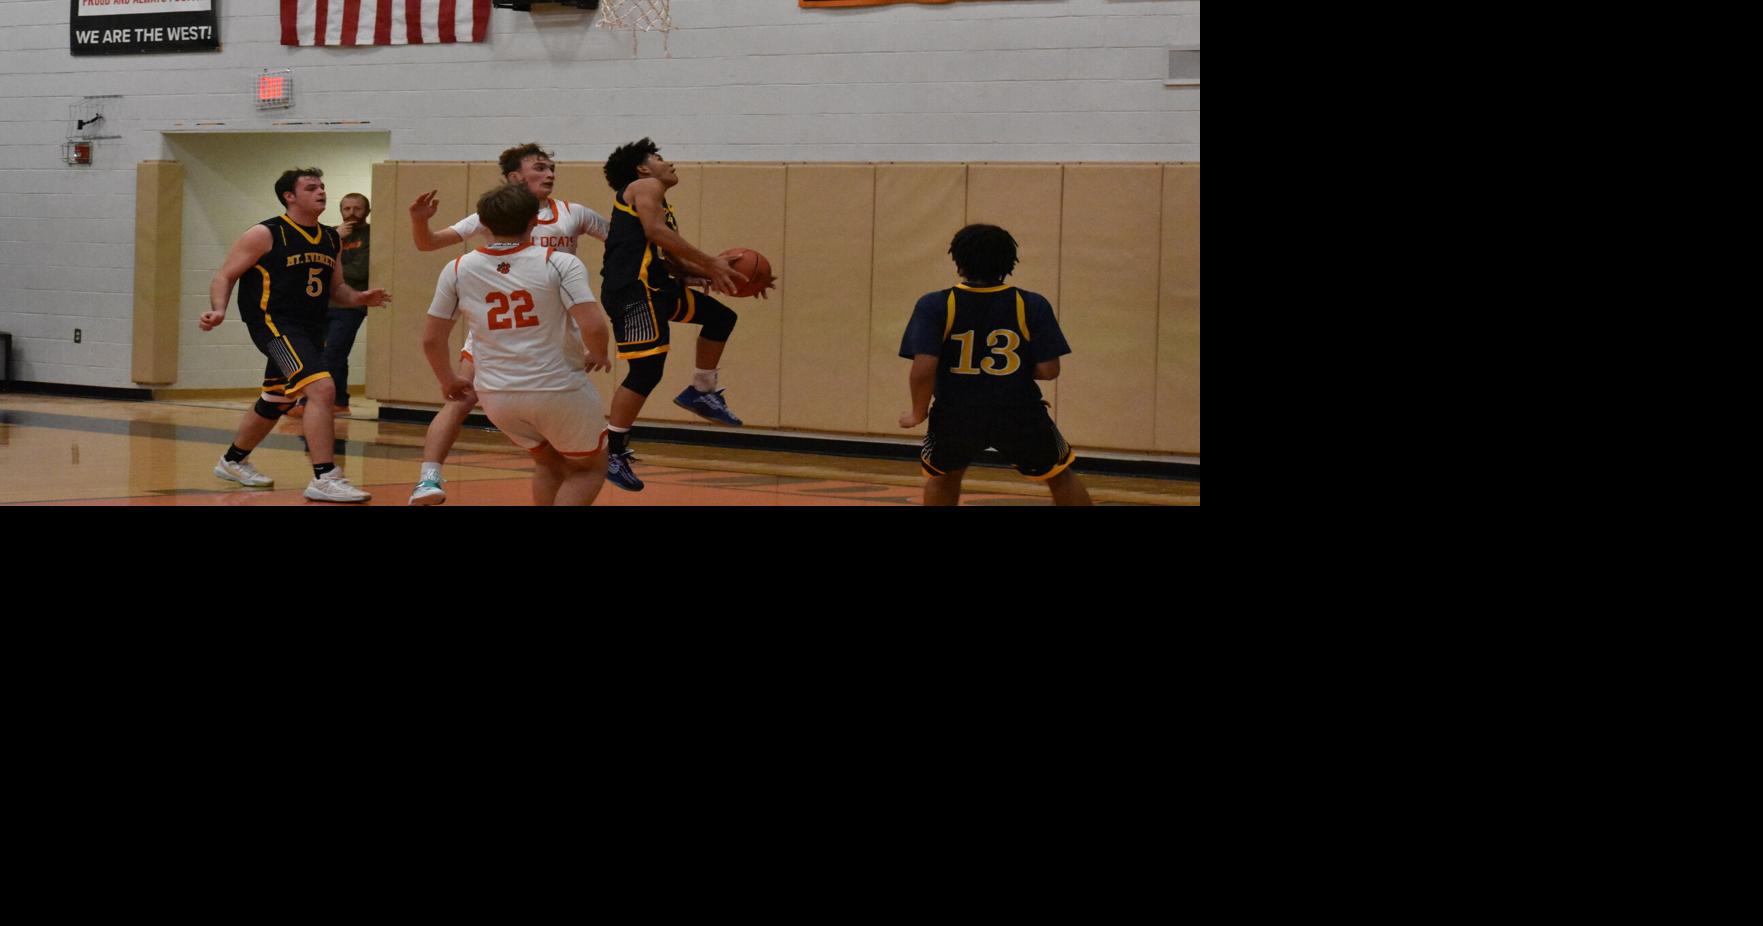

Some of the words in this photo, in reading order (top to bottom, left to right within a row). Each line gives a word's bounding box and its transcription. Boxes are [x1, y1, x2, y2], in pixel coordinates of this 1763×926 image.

[76, 30, 100, 44] WE
[102, 29, 131, 43] ARE
[134, 28, 163, 42] THE
[167, 26, 212, 41] WEST!
[286, 254, 304, 268] MT.
[306, 268, 323, 297] 5
[485, 289, 540, 330] 22
[950, 329, 1021, 376] 13
